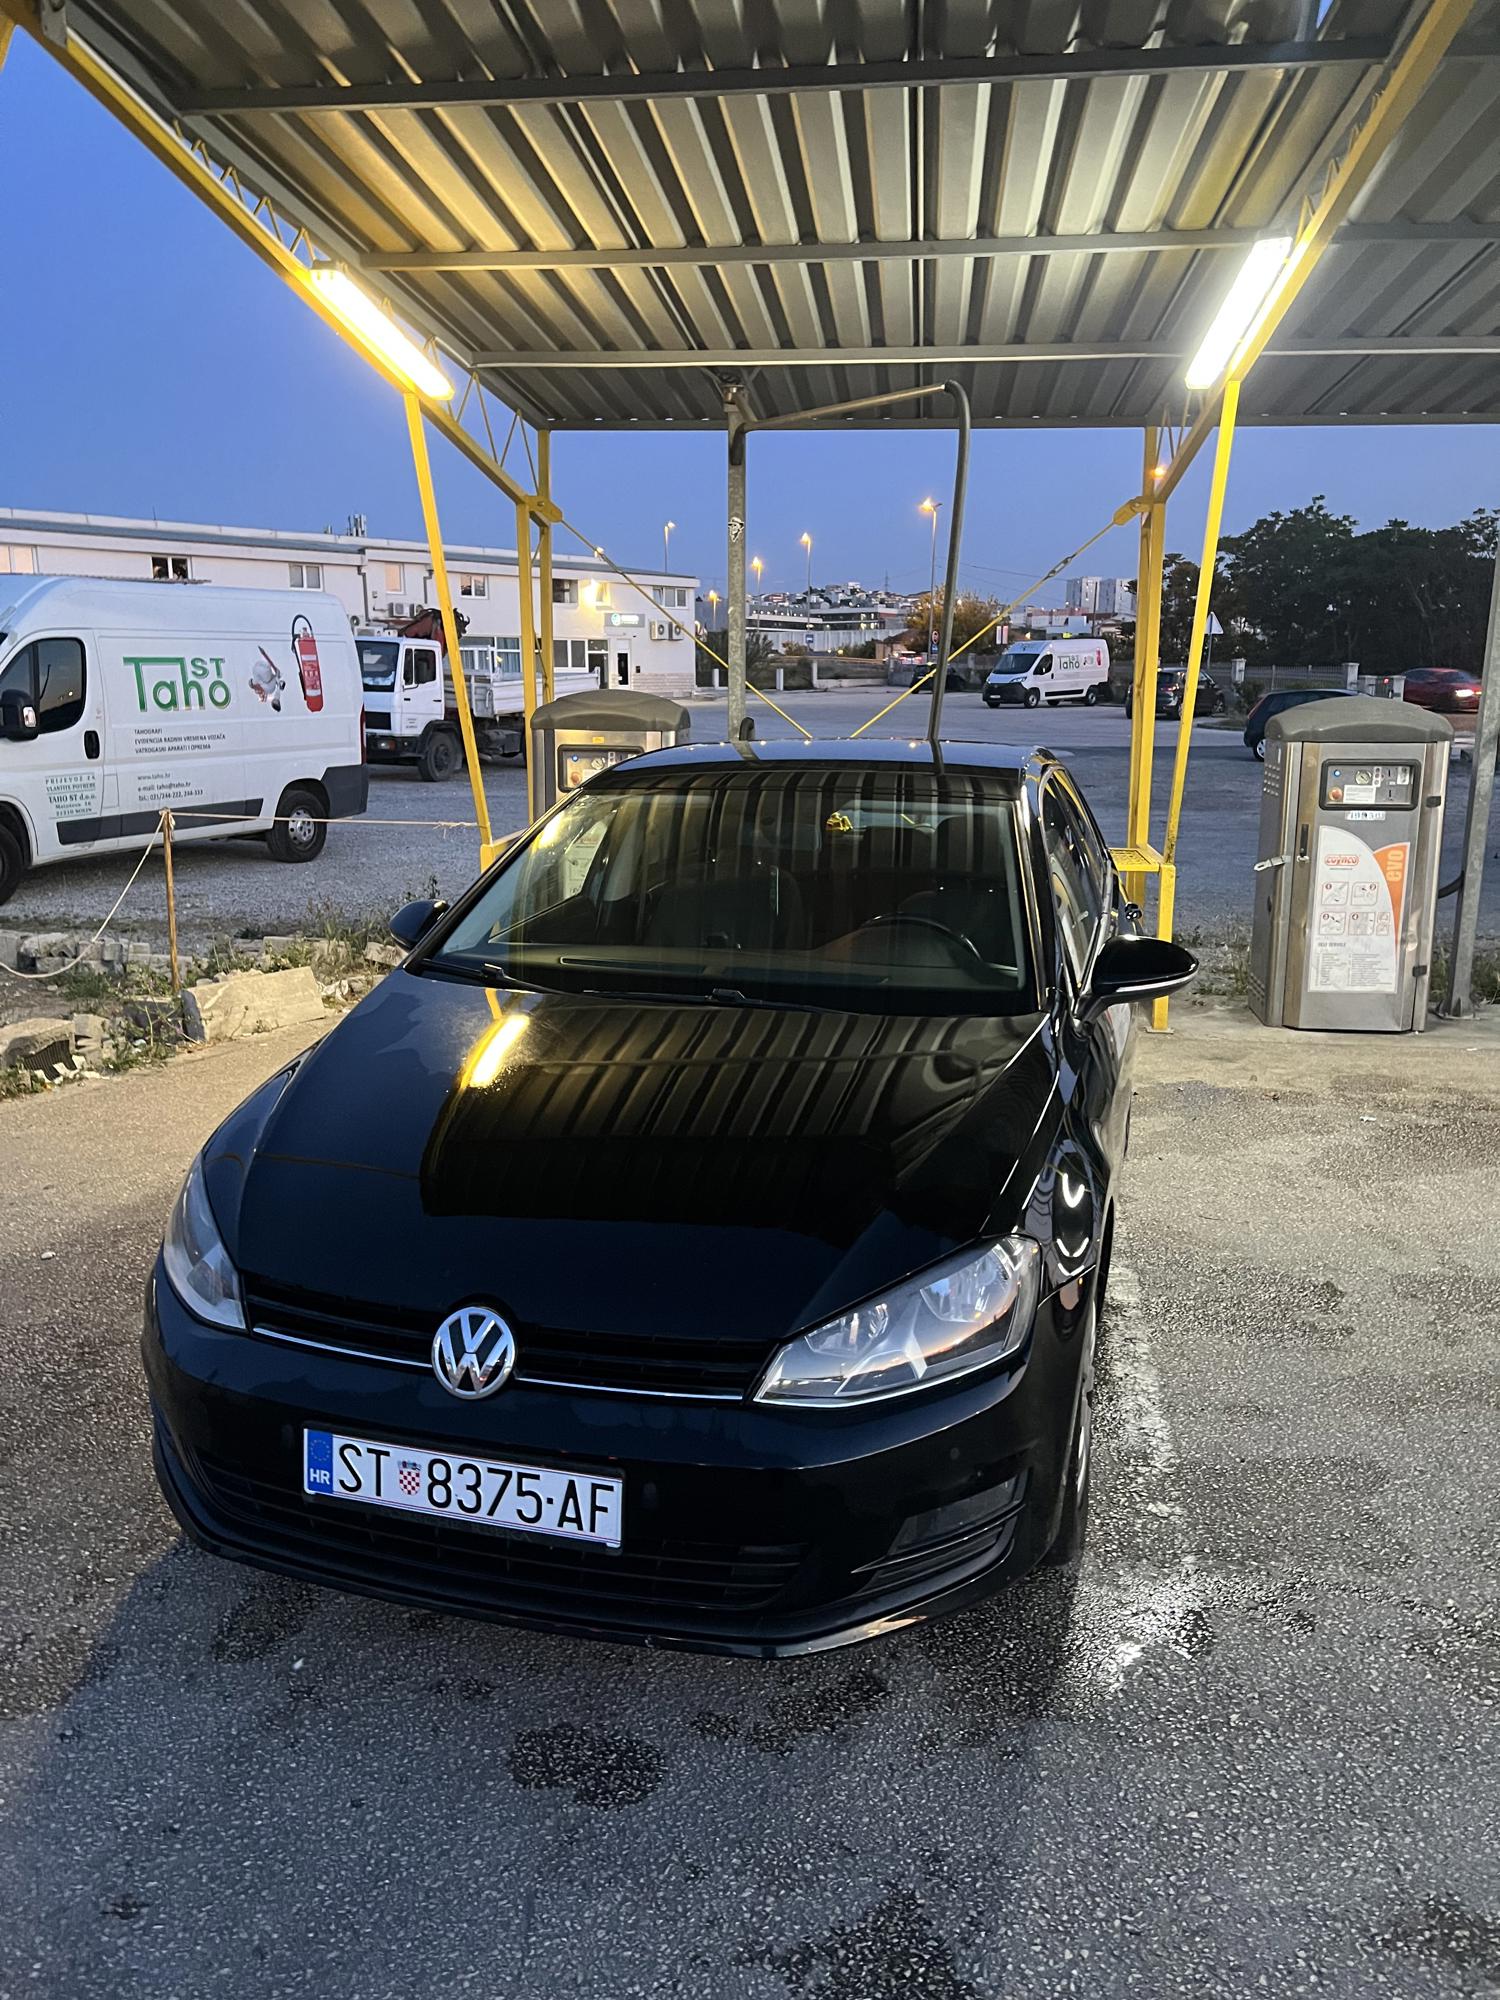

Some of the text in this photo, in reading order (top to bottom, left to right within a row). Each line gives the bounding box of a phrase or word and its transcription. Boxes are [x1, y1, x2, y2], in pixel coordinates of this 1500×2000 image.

[1057, 655, 1080, 670] Taho
[123, 656, 231, 712] Taho ST
[310, 1468, 330, 1486] HR
[338, 1443, 391, 1497] ST
